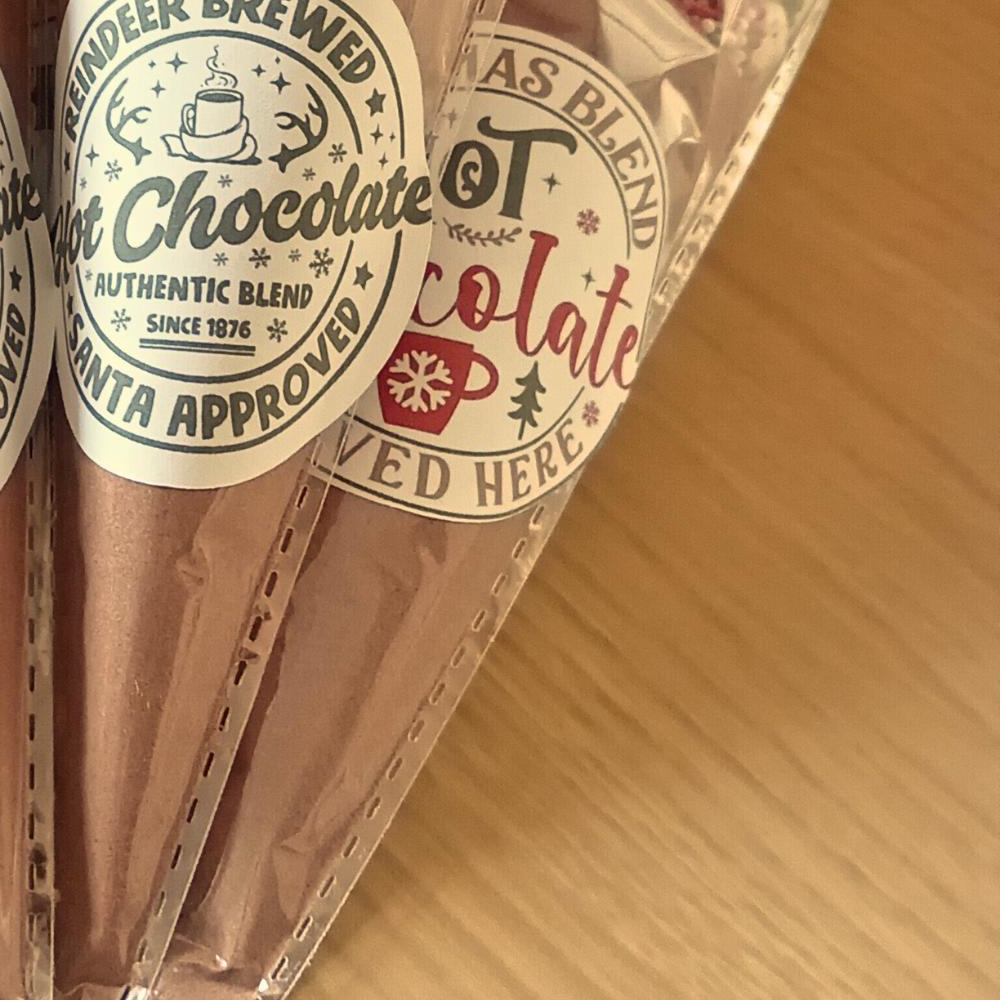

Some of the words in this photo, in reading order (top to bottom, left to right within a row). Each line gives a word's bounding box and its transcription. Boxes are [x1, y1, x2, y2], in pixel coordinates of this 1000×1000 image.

[563, 79, 658, 250] BLEND
[114, 162, 433, 264] Chocolate
[94, 272, 230, 303] AUTHENTIC
[238, 279, 314, 310] BLEND
[146, 315, 201, 336] SINCE
[207, 317, 252, 340] 1876
[68, 312, 155, 429] SANTA
[167, 297, 360, 440] APPROVED
[475, 418, 583, 508] HERE
